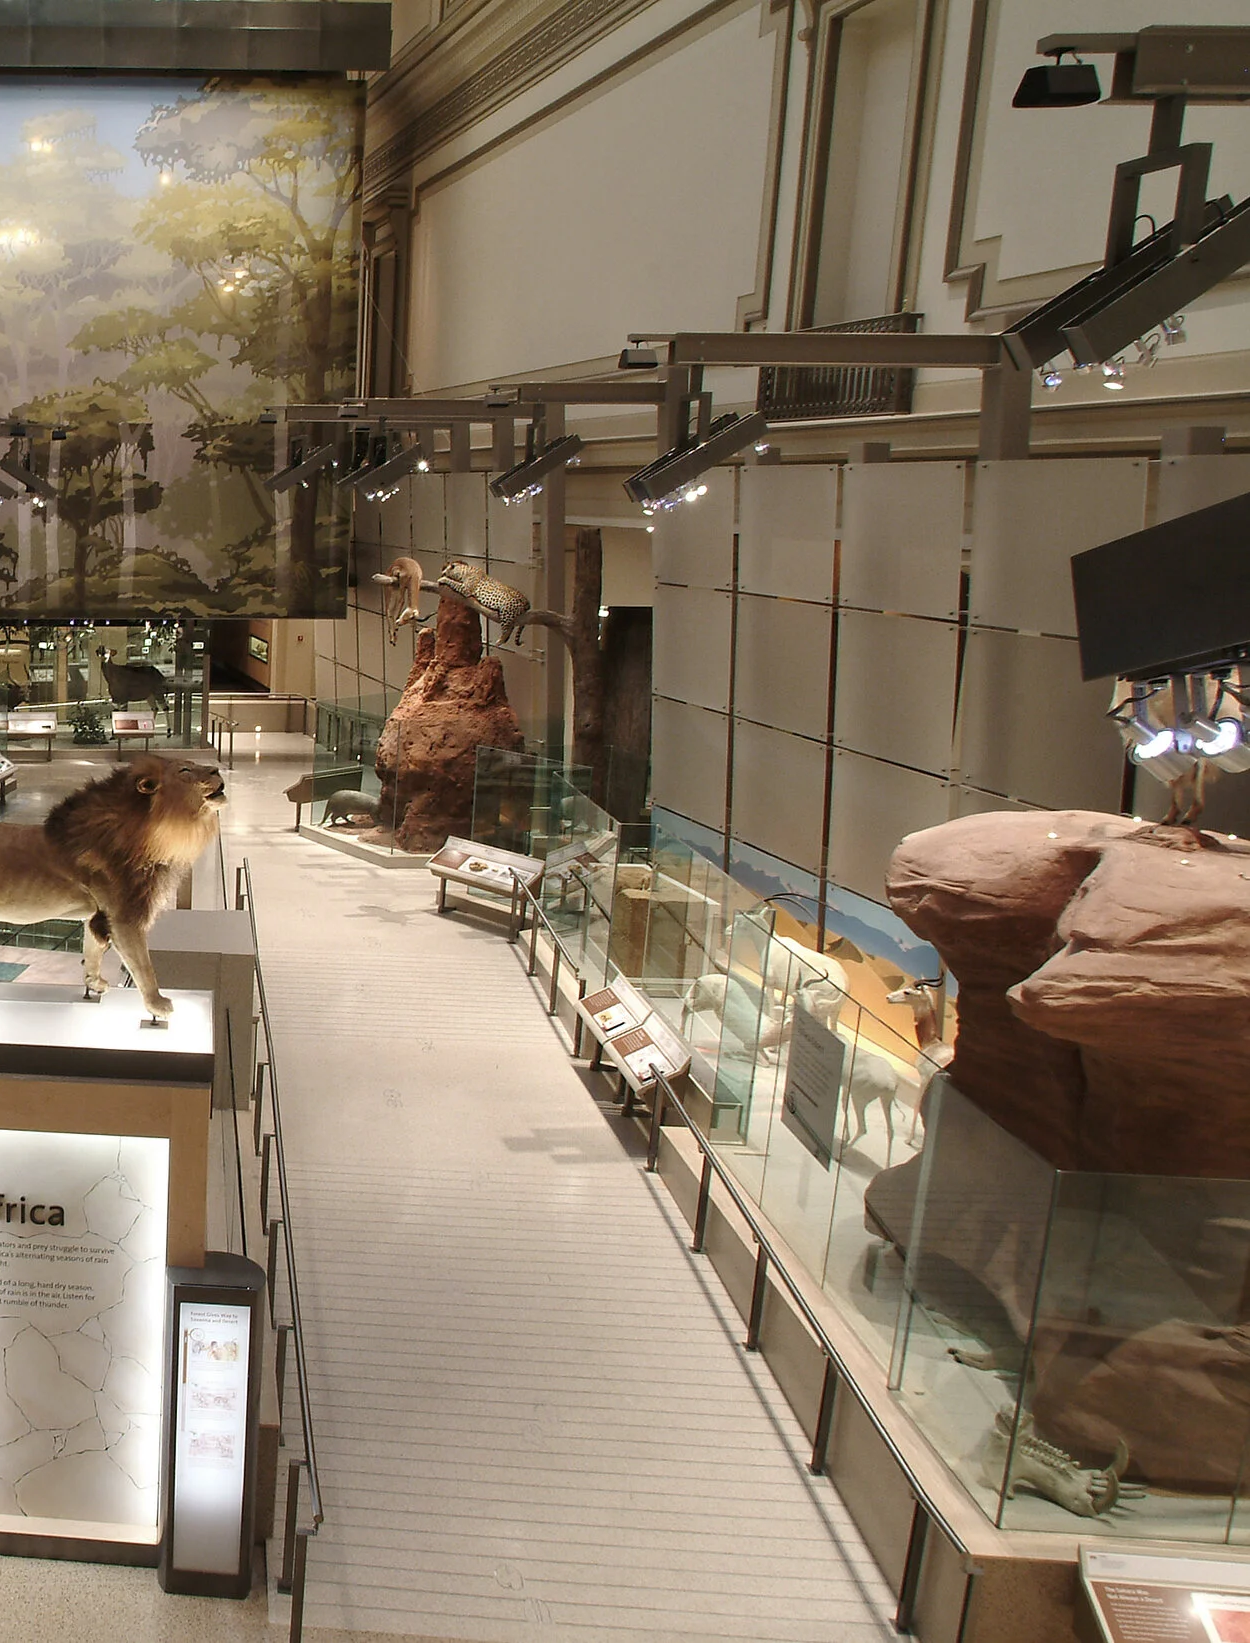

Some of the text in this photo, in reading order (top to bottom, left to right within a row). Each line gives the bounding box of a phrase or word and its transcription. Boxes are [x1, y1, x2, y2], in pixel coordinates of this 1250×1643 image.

[49, 1245, 79, 1253] struggle
[15, 1252, 55, 1262] alternating
[18, 1280, 36, 1289] long,
[55, 1282, 66, 1290] dry
[4, 1298, 28, 1306] rumble
[39, 1300, 69, 1309] thunder.
